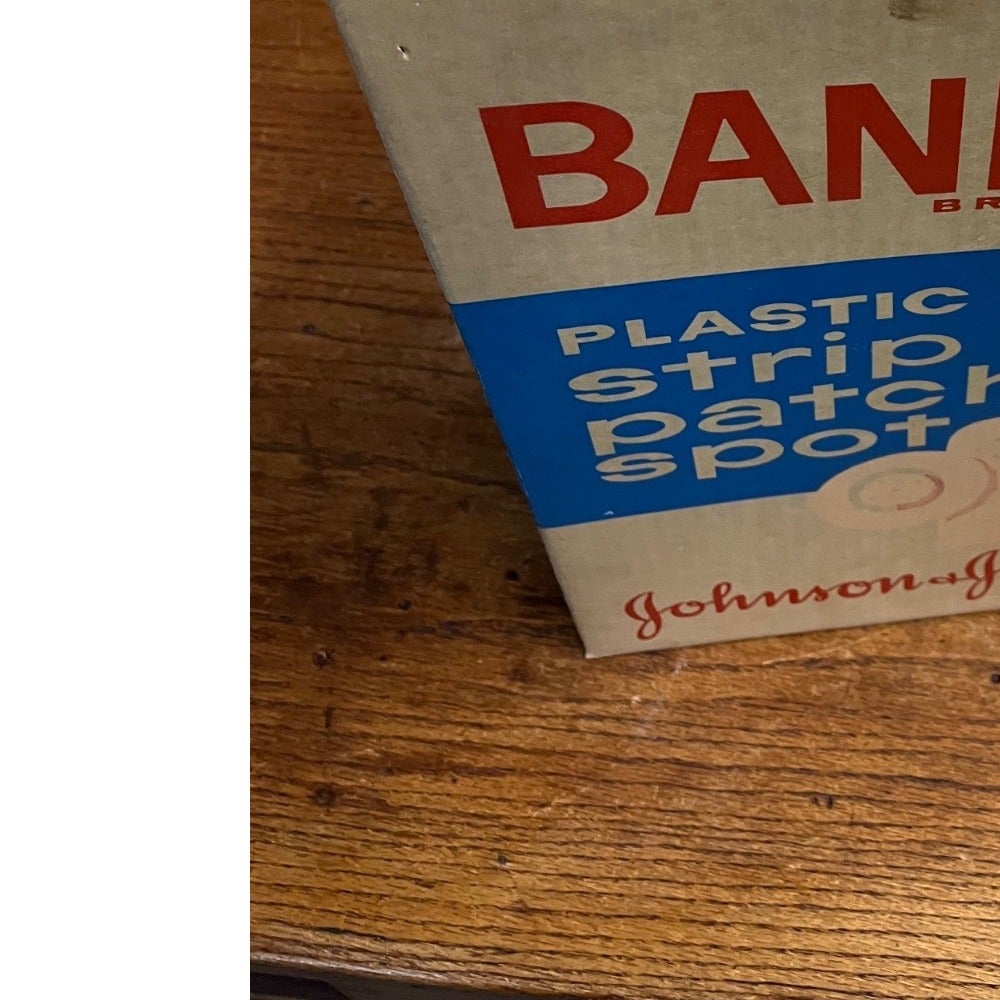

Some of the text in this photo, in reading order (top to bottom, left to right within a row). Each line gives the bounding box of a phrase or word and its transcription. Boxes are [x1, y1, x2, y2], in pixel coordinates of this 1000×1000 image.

[556, 286, 969, 356] PLASTIC
[568, 330, 962, 403] strip
[595, 414, 951, 482] spot
[623, 571, 924, 641] Johnson
